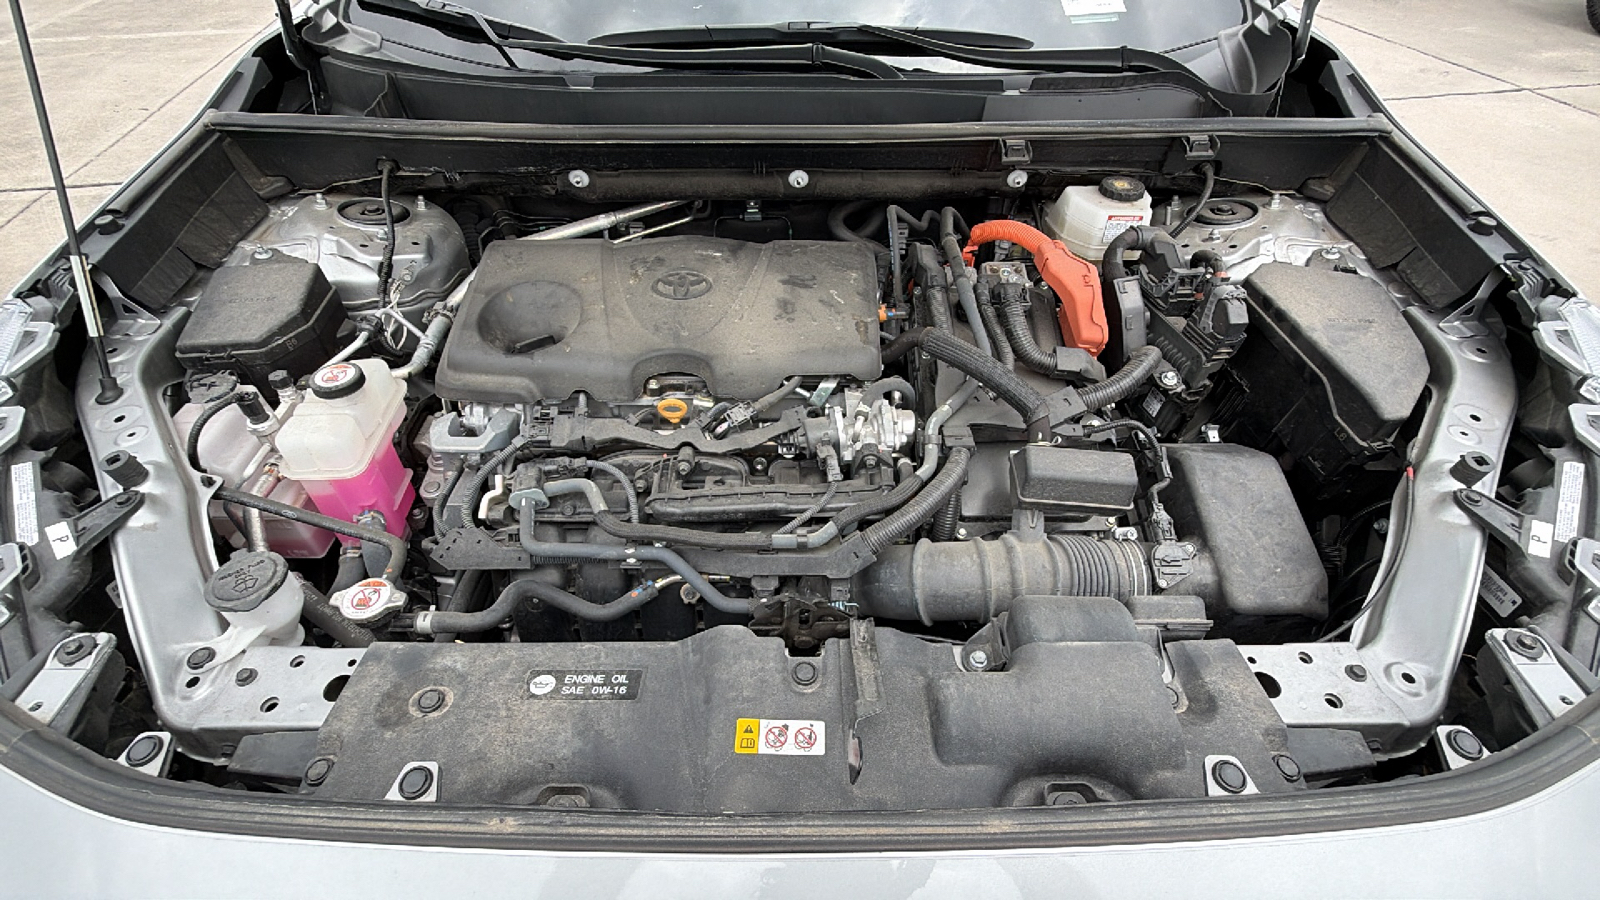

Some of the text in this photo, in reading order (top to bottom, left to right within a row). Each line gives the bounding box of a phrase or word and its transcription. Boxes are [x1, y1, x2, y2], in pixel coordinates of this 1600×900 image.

[564, 674, 629, 684] ENGINE OIL
[560, 686, 585, 694] SAE
